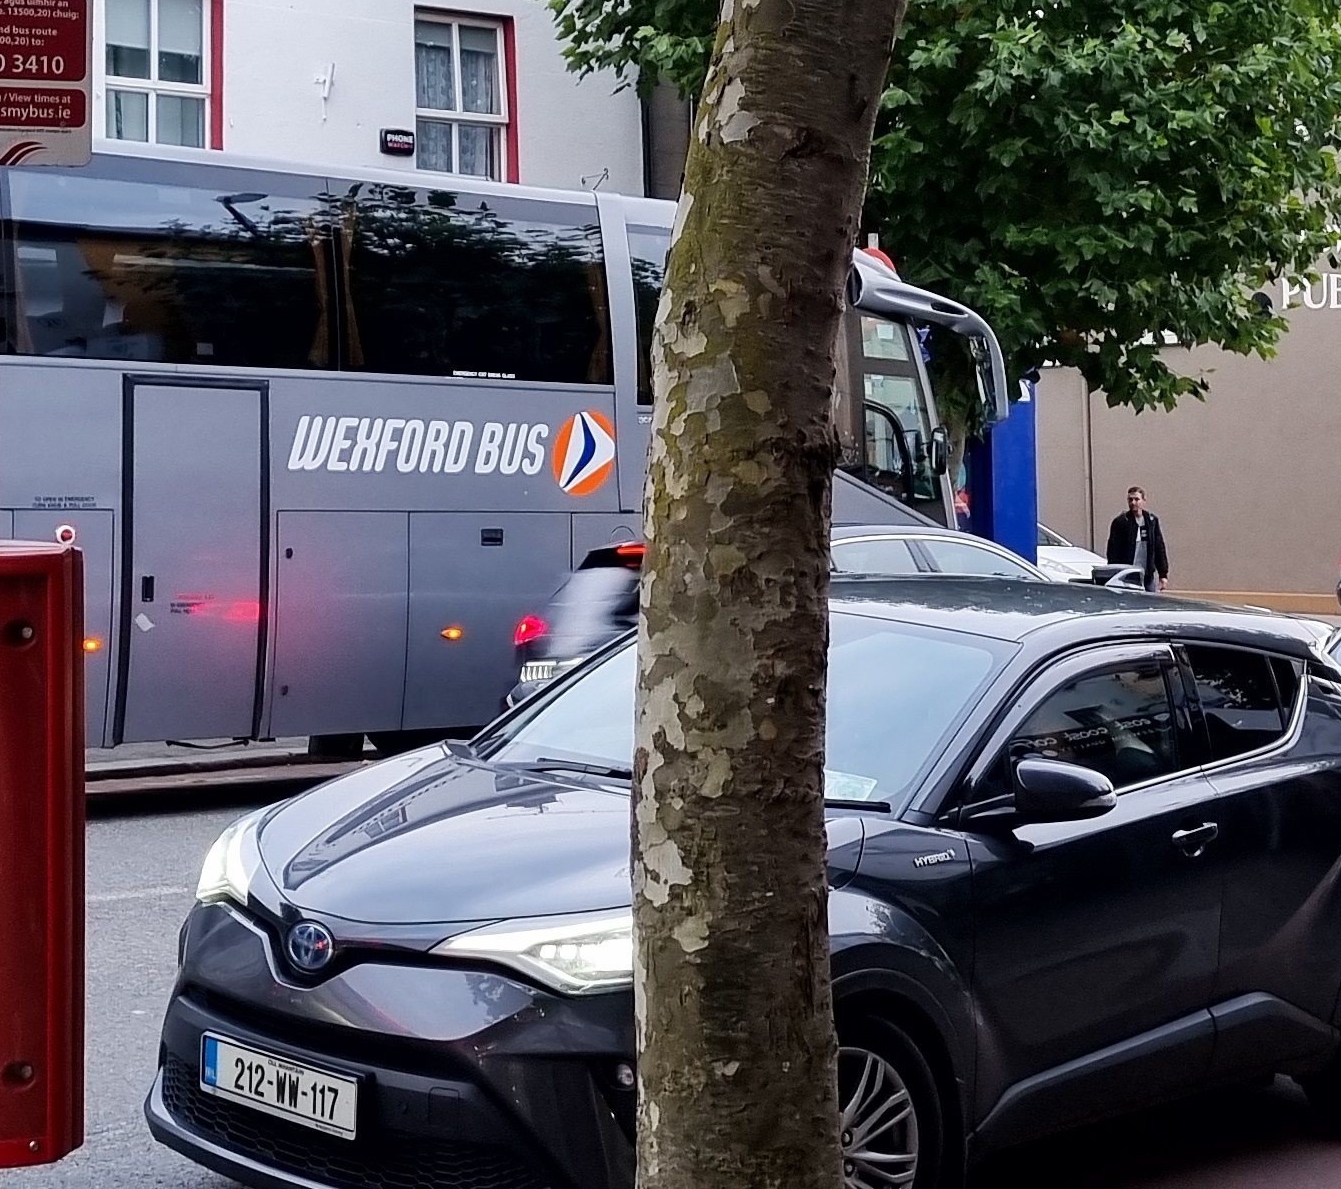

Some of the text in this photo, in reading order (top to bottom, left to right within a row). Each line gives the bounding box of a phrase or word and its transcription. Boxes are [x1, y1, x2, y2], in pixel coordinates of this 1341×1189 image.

[12, 25, 29, 35] bus
[32, 28, 58, 36] route
[31, 37, 45, 46] to:
[12, 54, 64, 74] 3410
[8, 93, 32, 102] View
[34, 94, 60, 103] times
[61, 96, 71, 104] at
[287, 415, 549, 475] WEXFORD BUS
[233, 1057, 340, 1121] 212-WW-117
